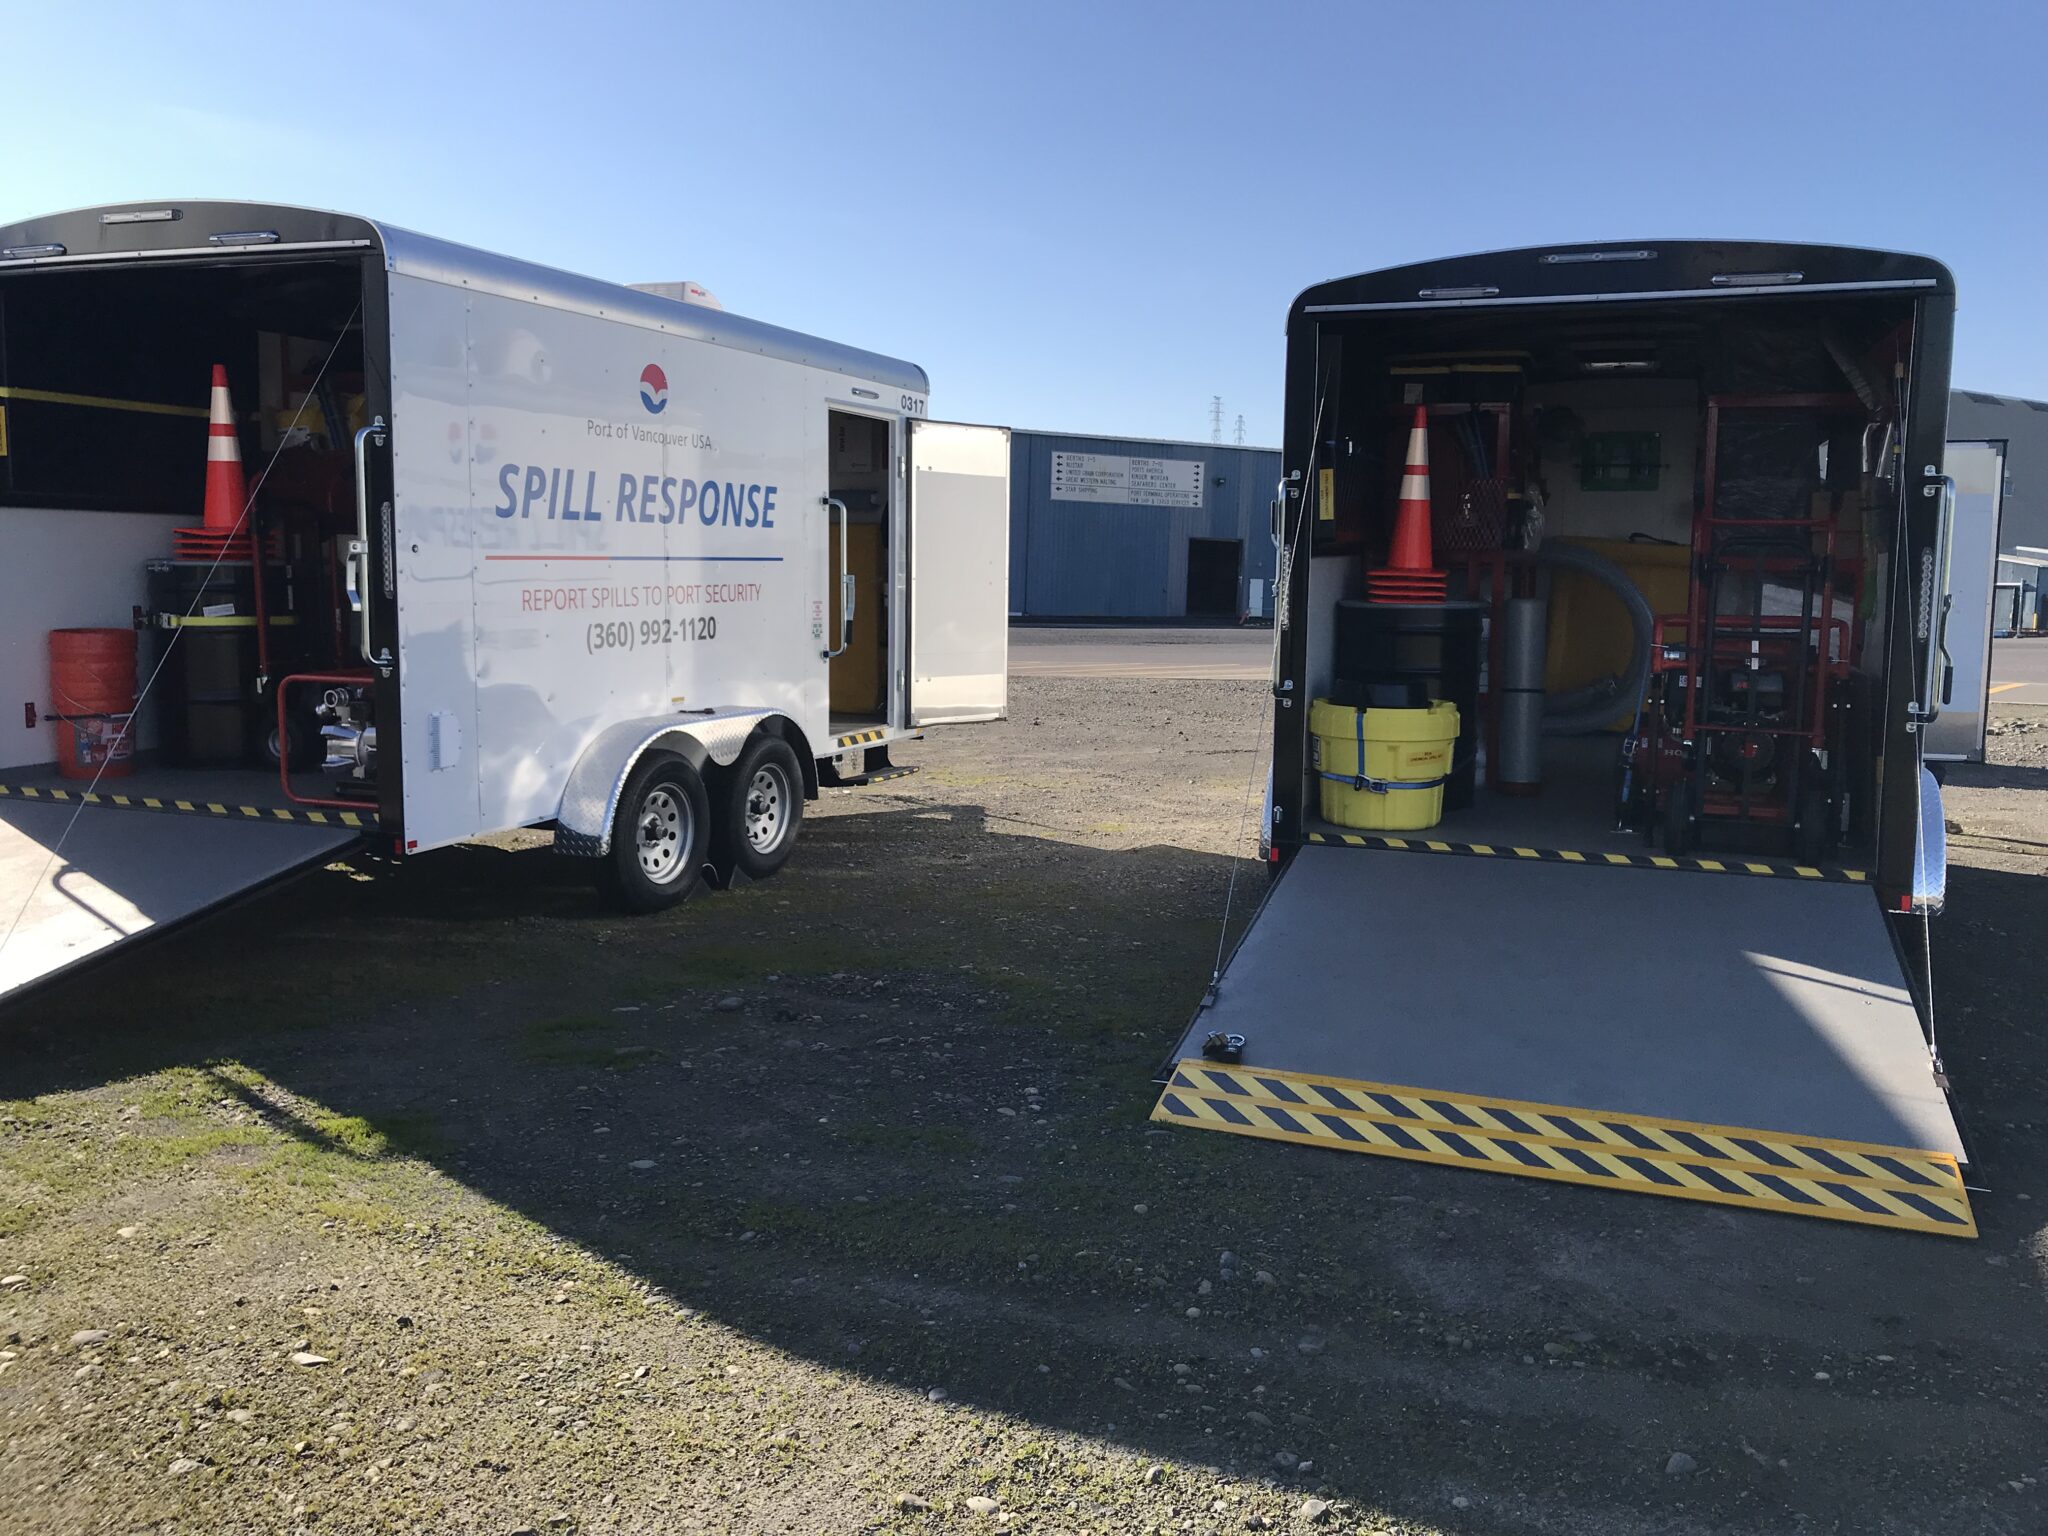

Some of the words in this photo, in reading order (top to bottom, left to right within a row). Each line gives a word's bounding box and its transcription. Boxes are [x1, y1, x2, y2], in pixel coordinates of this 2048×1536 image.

[901, 394, 924, 415] 0317
[587, 419, 612, 438] Port
[616, 423, 629, 439] of
[632, 425, 688, 446] Vancouver
[691, 433, 712, 450] USA
[495, 463, 602, 521] SPILL
[615, 473, 778, 528] RESPONSE
[522, 588, 588, 612] REPORT
[591, 586, 640, 609] SPILLS
[643, 586, 663, 606] TO
[667, 585, 703, 605] PORT
[704, 583, 762, 604] SECURITY
[586, 621, 635, 655] (360)
[640, 616, 717, 646] 992-1120
